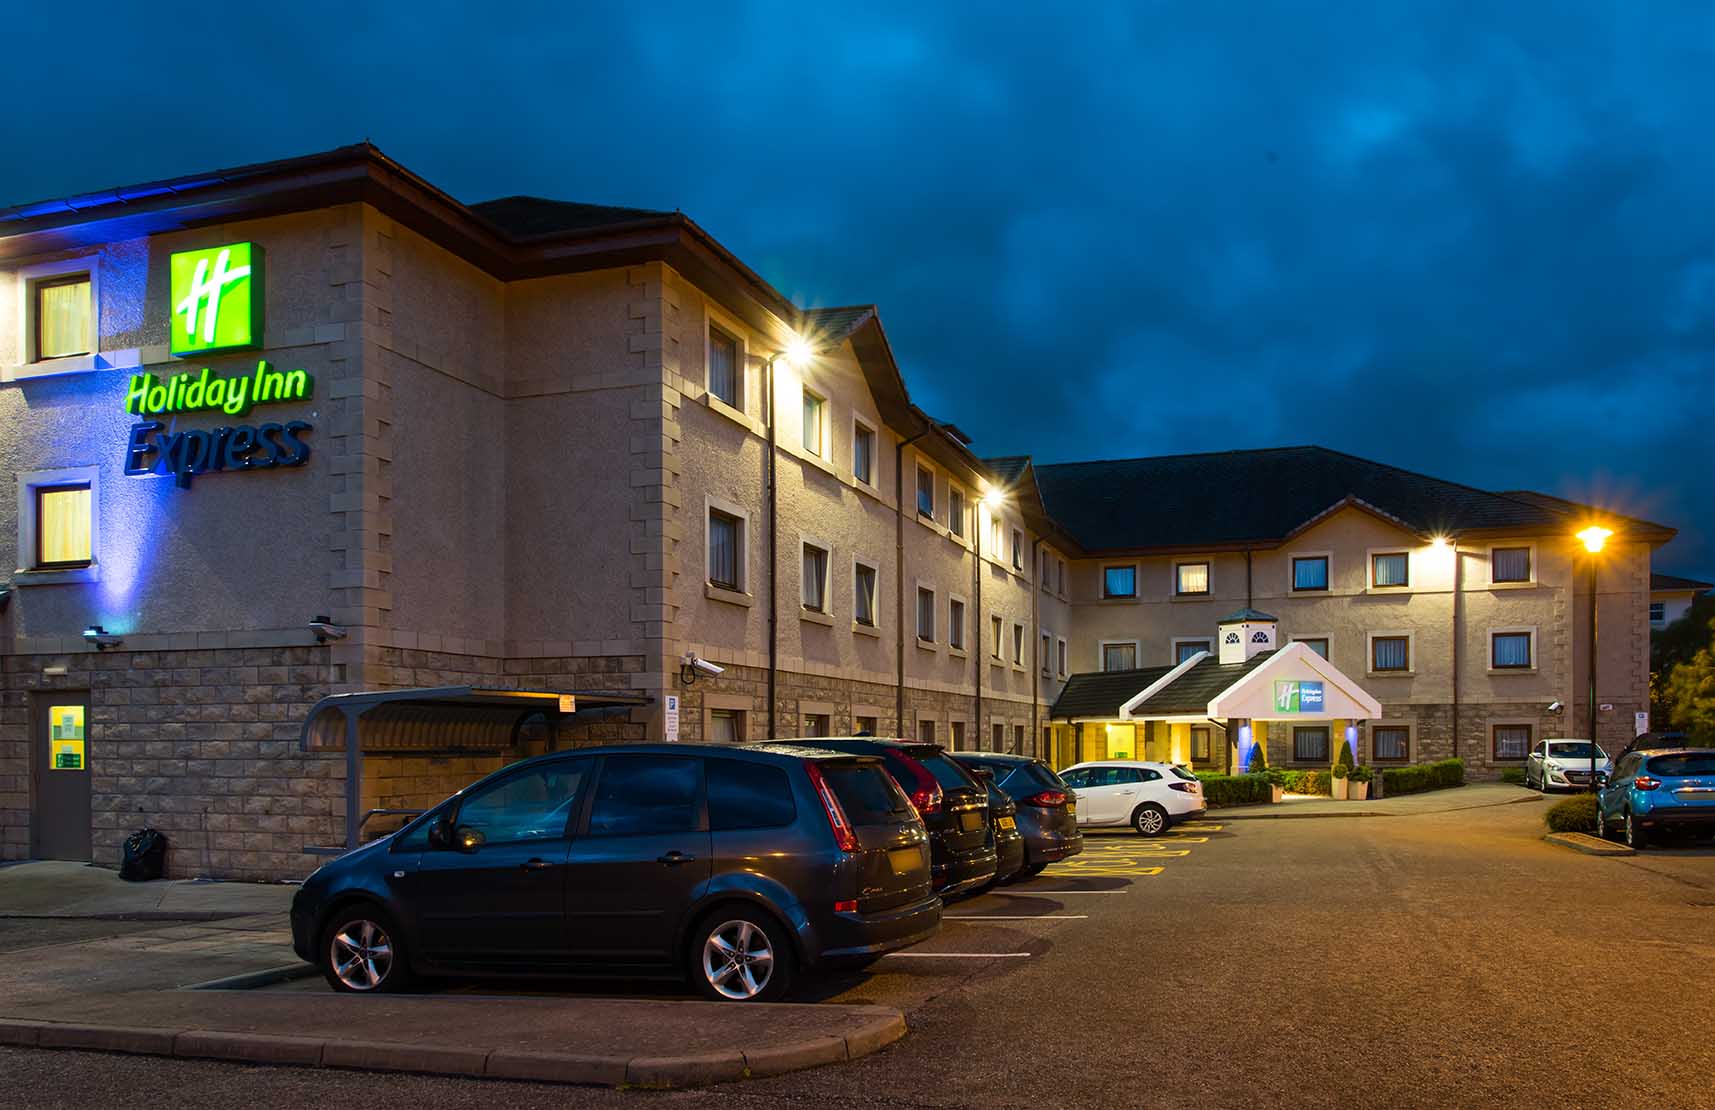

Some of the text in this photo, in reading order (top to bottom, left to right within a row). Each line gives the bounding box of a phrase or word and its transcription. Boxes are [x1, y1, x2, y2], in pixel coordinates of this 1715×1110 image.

[176, 249, 251, 343] H
[125, 361, 307, 414] Holiday Inn
[124, 420, 312, 489] Express
